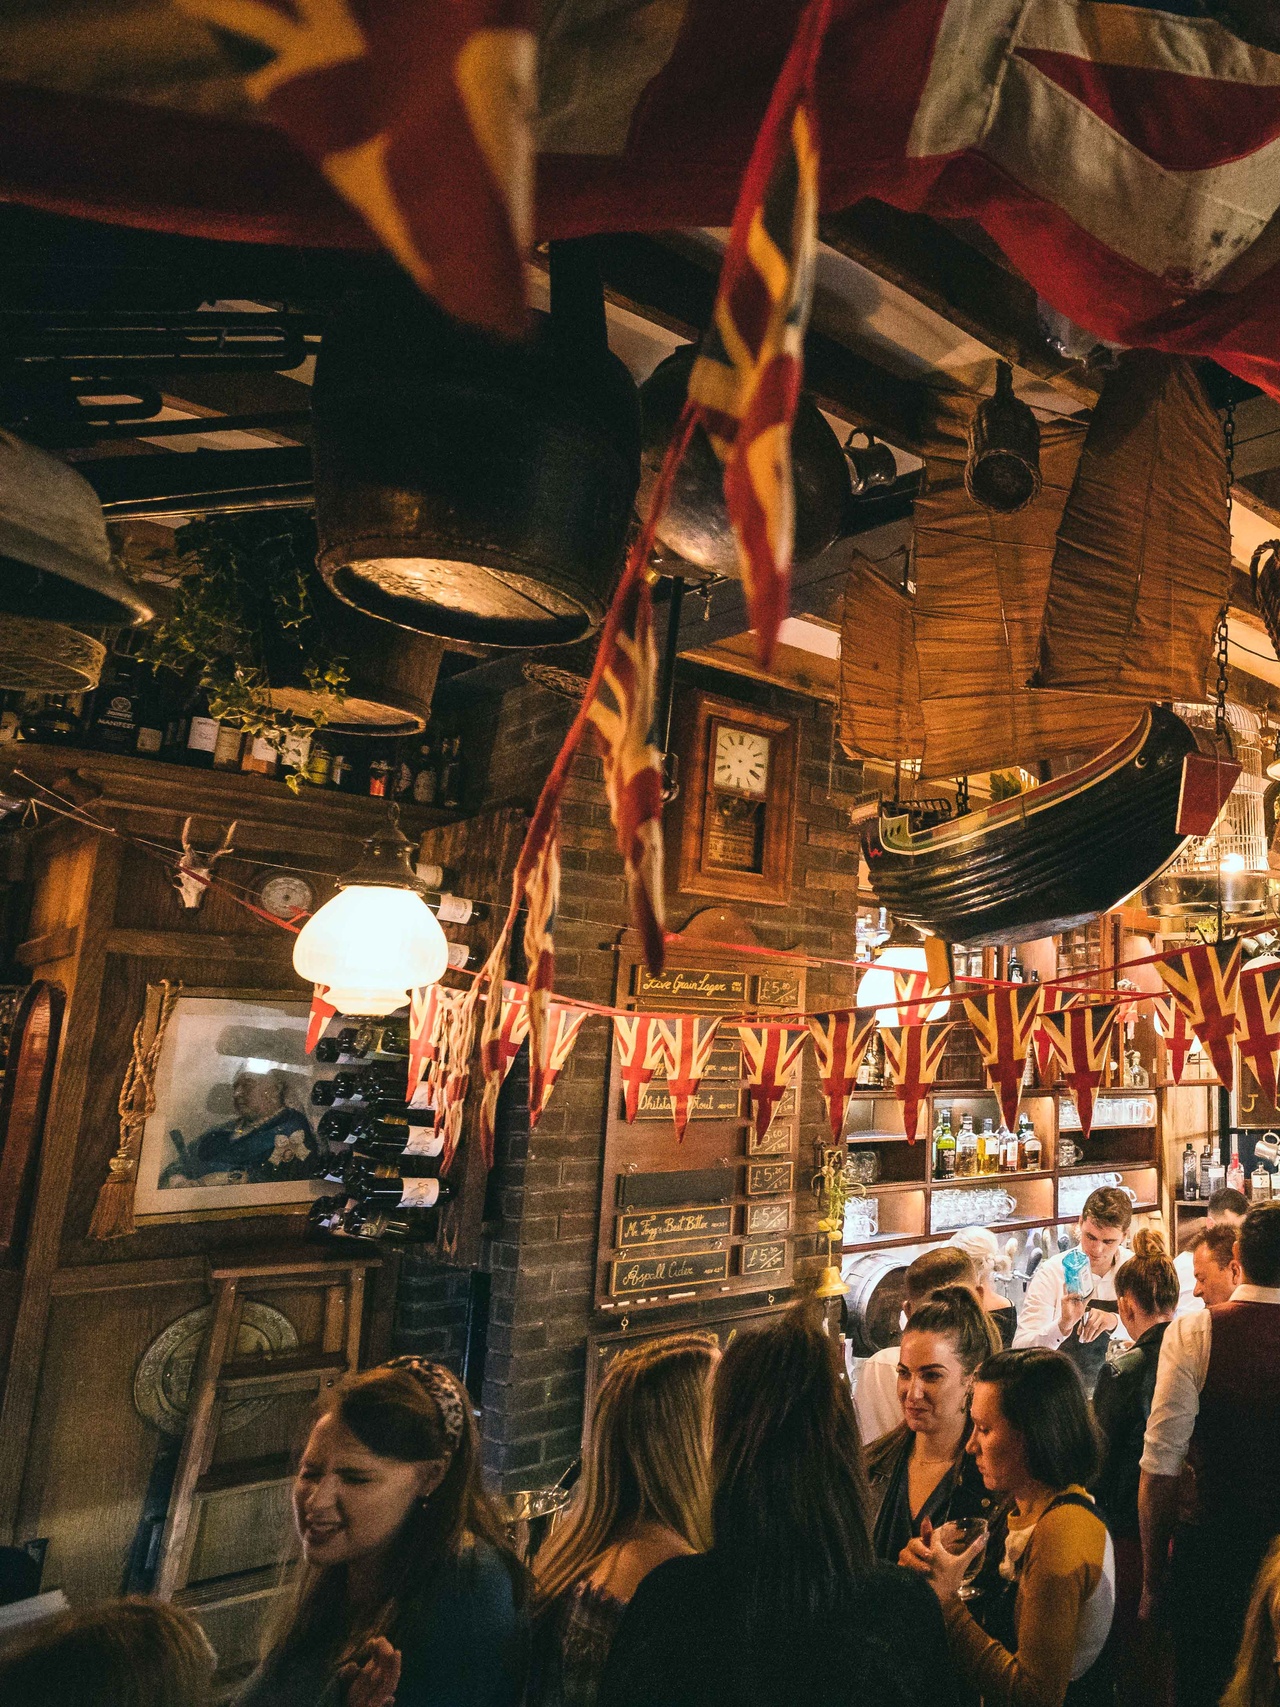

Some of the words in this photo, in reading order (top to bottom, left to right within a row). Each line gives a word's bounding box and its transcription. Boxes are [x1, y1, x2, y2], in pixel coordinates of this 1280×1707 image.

[673, 973, 698, 994] Grain
[697, 973, 727, 996] Lager
[663, 1216, 684, 1233] Best
[684, 1214, 709, 1232] Bitter
[622, 1262, 666, 1288] Aspall
[668, 1260, 694, 1278] Cider
